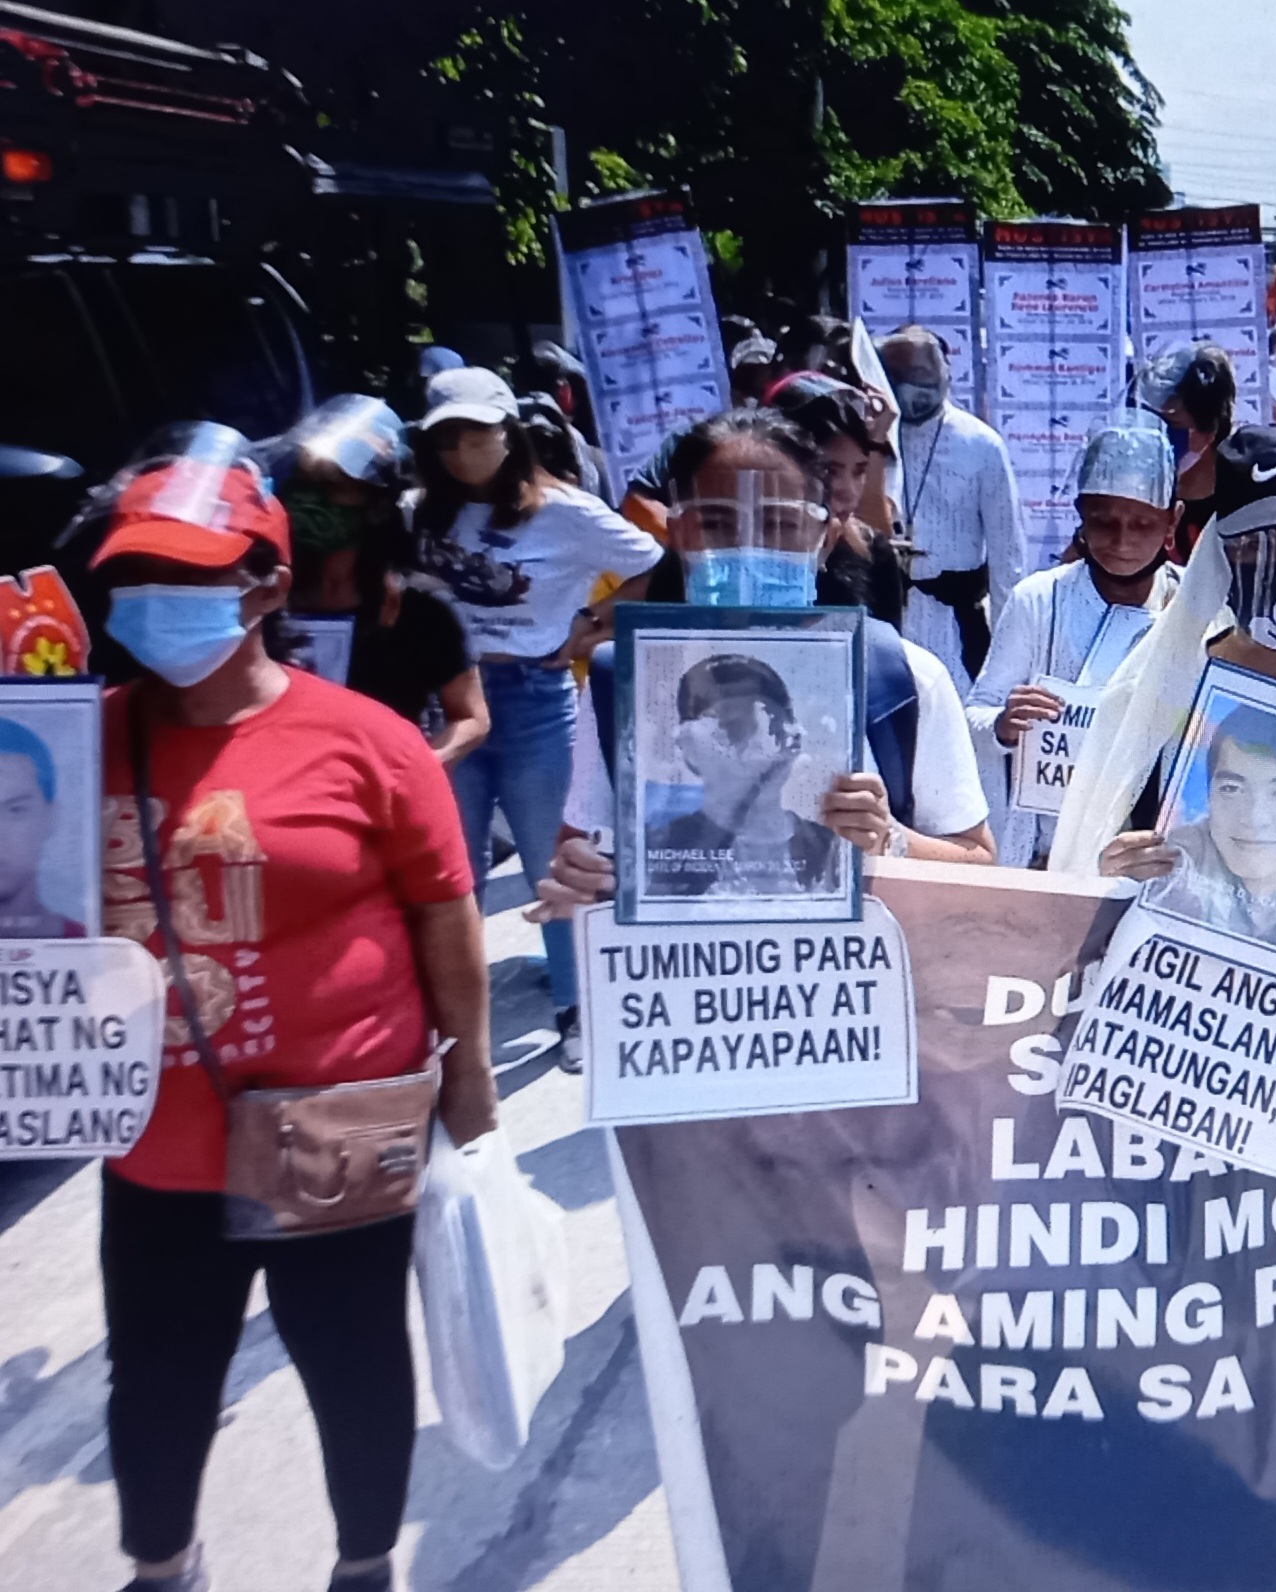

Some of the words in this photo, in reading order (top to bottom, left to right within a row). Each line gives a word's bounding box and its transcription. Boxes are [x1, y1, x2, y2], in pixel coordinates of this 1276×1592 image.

[1041, 731, 1069, 758] SA
[648, 850, 706, 861] MICHAEL
[710, 850, 735, 862] LEE
[600, 938, 781, 983] TUMINDIG
[793, 936, 892, 973] PARA
[620, 992, 672, 1030] SA
[694, 983, 820, 1025] BUHAY
[831, 980, 878, 1017] AT
[72, 1014, 127, 1050] NG
[618, 1025, 882, 1079] KAPAYAPAAN!
[101, 1060, 149, 1096] NG
[903, 1202, 1168, 1272] HINDI
[679, 1264, 881, 1327] ANG
[914, 1282, 1223, 1349] AMING
[864, 1342, 1105, 1419] PARA
[1137, 1356, 1255, 1421] SA
